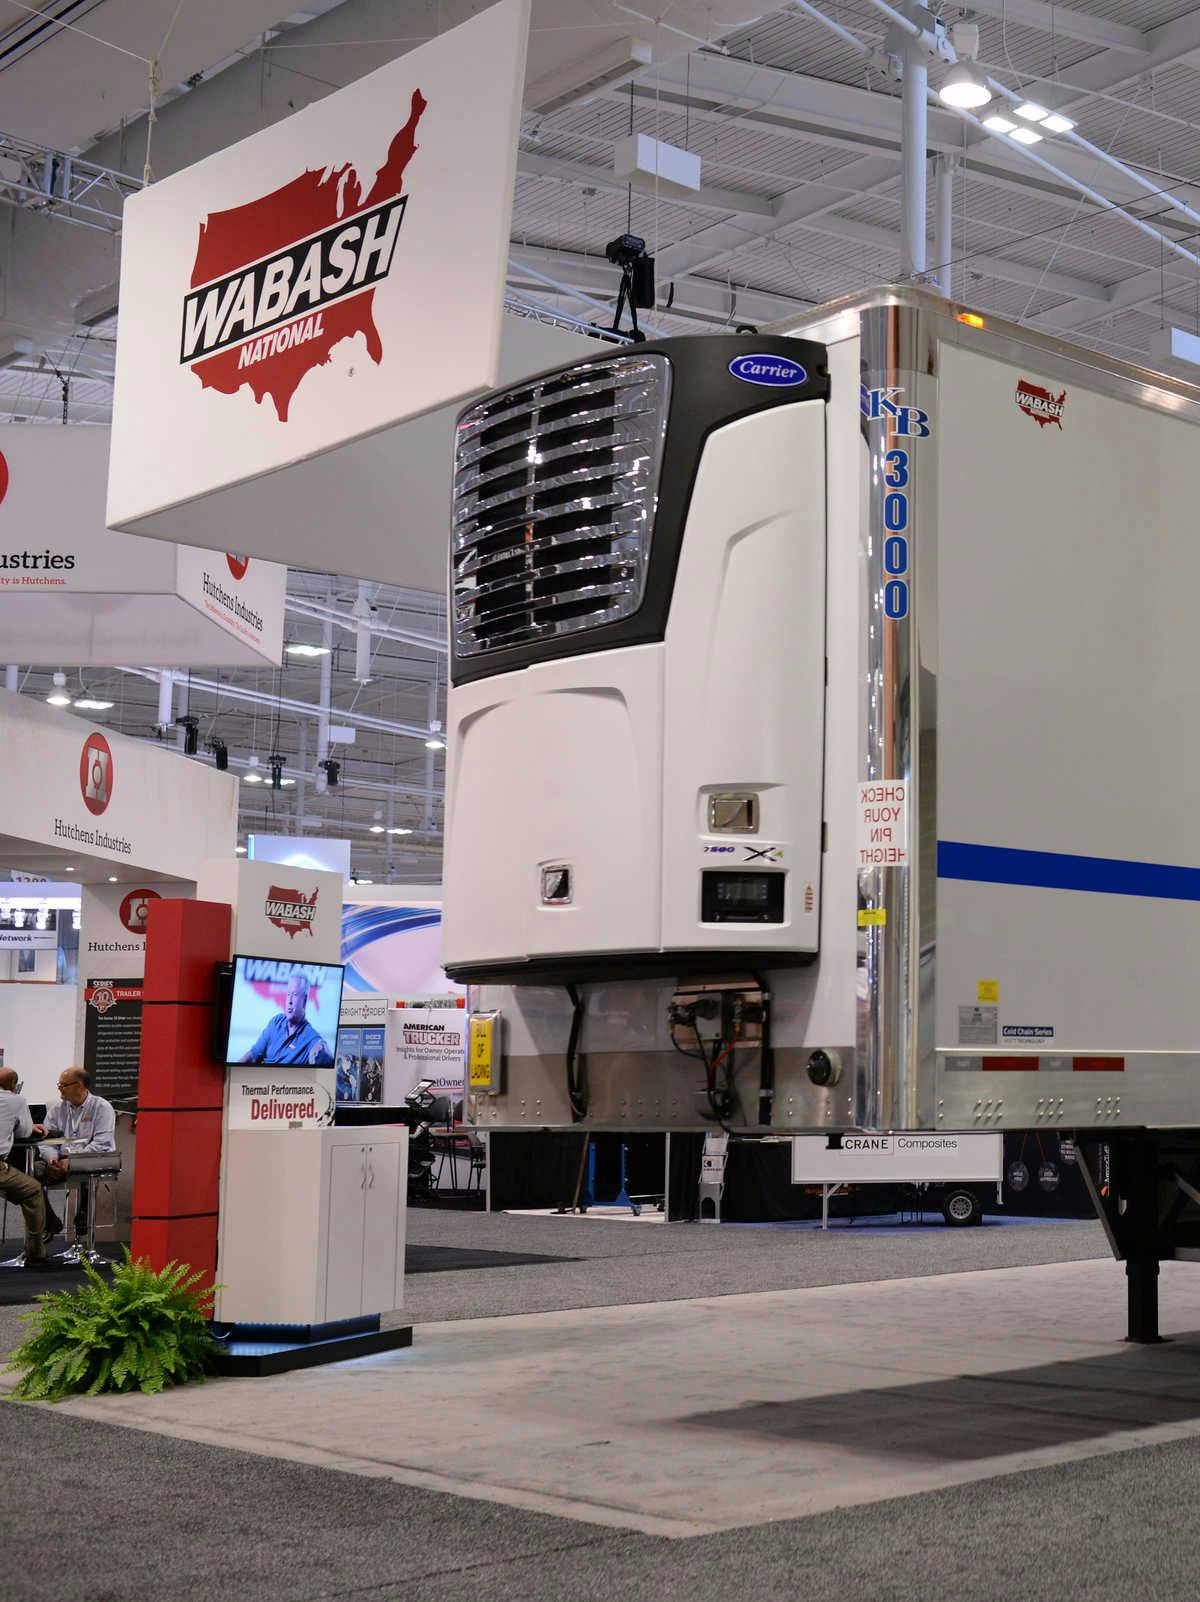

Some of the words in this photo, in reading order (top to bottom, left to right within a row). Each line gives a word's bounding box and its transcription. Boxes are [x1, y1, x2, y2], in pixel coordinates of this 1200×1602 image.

[183, 203, 404, 358] WABASH
[237, 313, 324, 370] NATIONAL
[740, 361, 798, 378] Carrier
[1016, 392, 1064, 416] WABASH
[884, 449, 909, 620] 3000
[22, 576, 66, 585] Hutchens.
[203, 572, 233, 611] Hutchens
[235, 595, 263, 632] Industries
[54, 818, 94, 845] Hutchens
[95, 830, 132, 854] Industries
[265, 903, 316, 919] WABASH
[88, 942, 140, 952] Hutchens
[403, 1023, 445, 1031] AMERICAN
[403, 1031, 461, 1046] TRUCKER
[241, 1085, 269, 1095] Thermal
[271, 1085, 315, 1095] Performance.
[251, 1099, 318, 1120] Delivered.
[845, 1139, 889, 1150] CRANE
[897, 1137, 958, 1150] Composites
